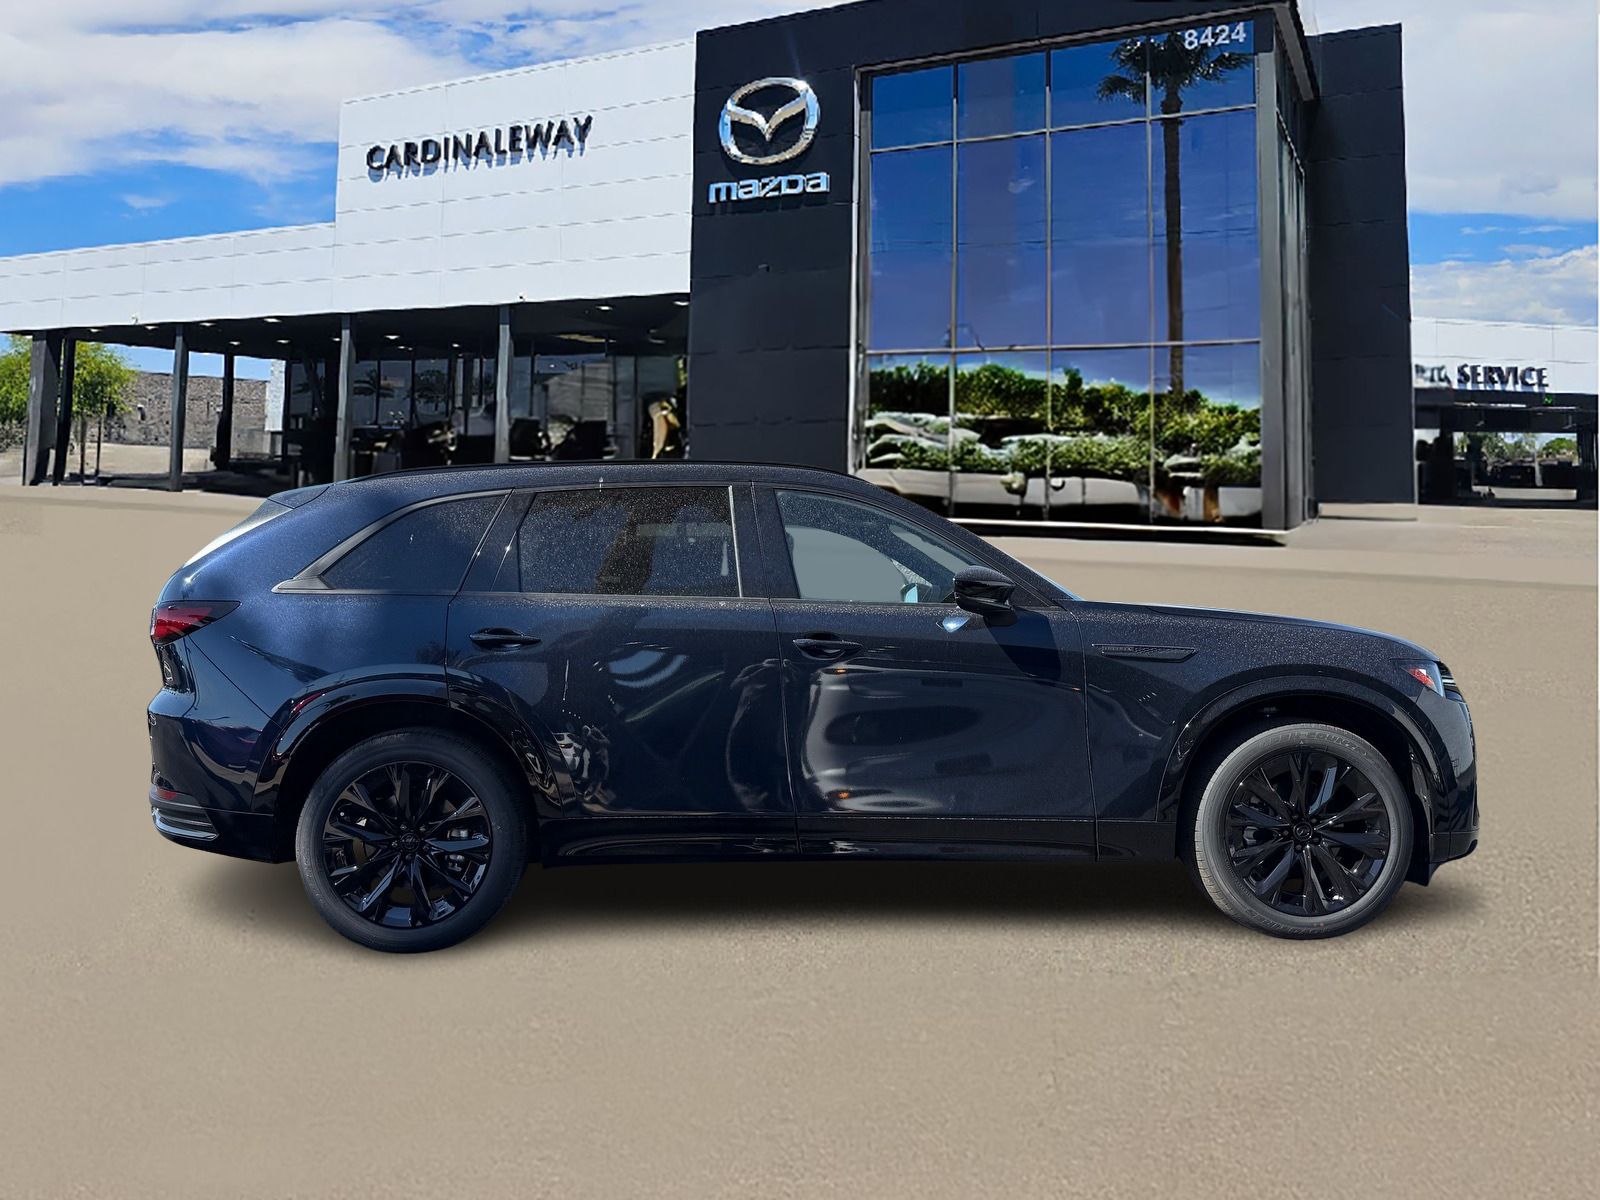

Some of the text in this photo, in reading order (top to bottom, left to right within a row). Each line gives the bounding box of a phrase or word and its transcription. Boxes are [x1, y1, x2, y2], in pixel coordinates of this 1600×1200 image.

[1184, 21, 1247, 50] 8424
[366, 114, 593, 171] CARDINALEWAY
[1457, 363, 1549, 388] SERVICE
